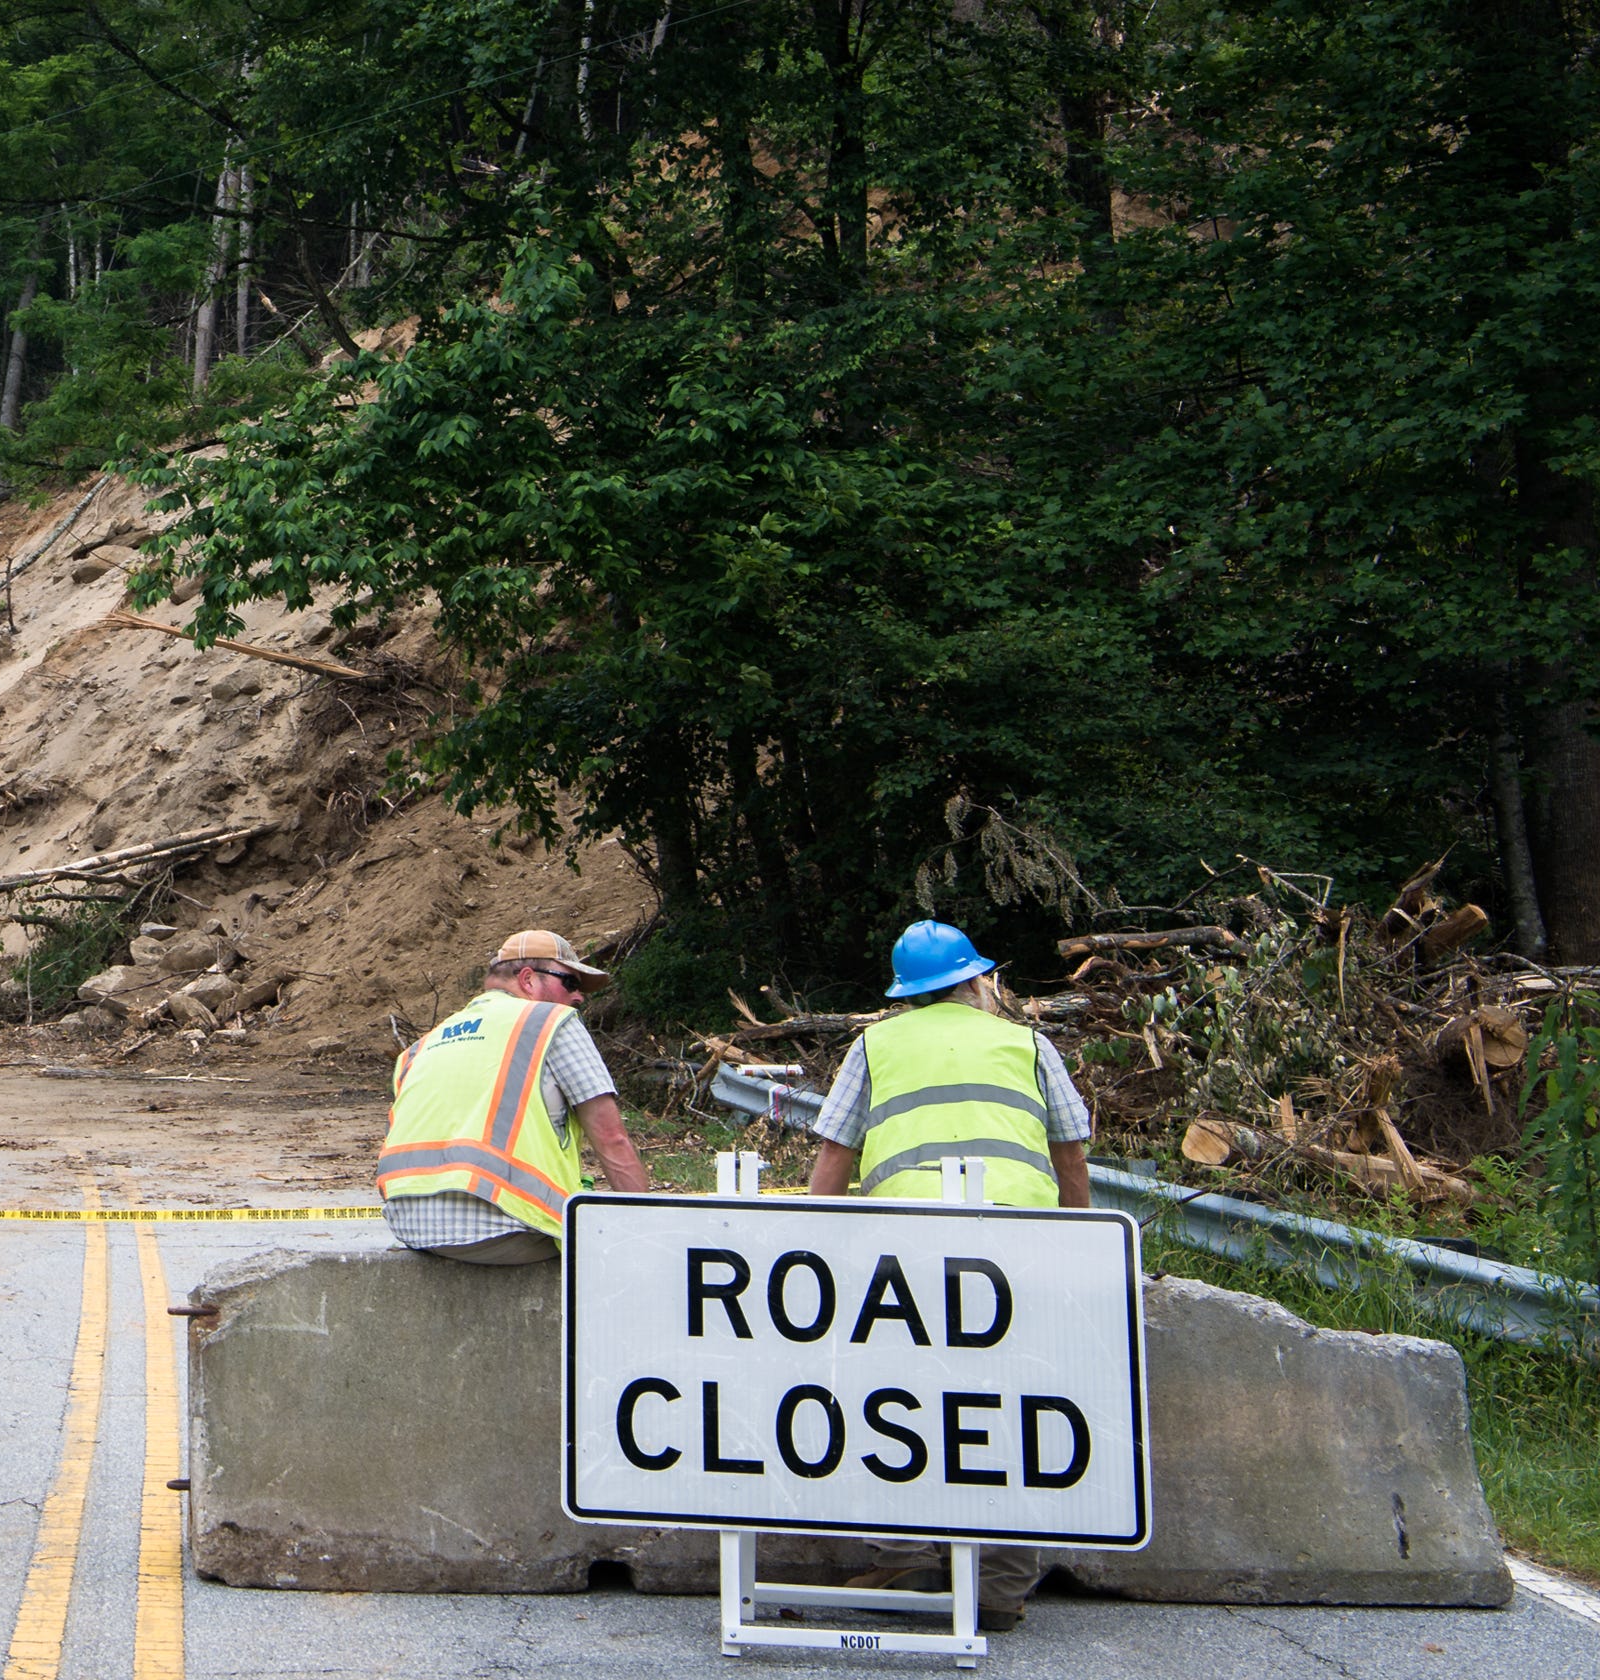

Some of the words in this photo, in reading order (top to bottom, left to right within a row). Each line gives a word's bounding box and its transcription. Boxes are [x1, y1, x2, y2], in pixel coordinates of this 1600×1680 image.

[96, 1211, 107, 1219] FIRE
[108, 1211, 120, 1219] LINE
[129, 1211, 139, 1219] NOT
[140, 1211, 157, 1220] CROSS
[172, 1211, 183, 1220] FIRE
[184, 1211, 195, 1220] LINE
[205, 1211, 215, 1220] NOT
[216, 1211, 233, 1220] CROSS
[248, 1210, 259, 1219] FIRE
[260, 1210, 271, 1219] LINE
[281, 1210, 291, 1219] NOT
[292, 1209, 309, 1219] CROSS
[324, 1209, 335, 1218] FIRE
[336, 1208, 347, 1218] LINE
[357, 1208, 367, 1218] NOT
[368, 1207, 381, 1218] CROS
[687, 1247, 1012, 1348] ROAD
[616, 1377, 1091, 1489] CLOSED
[840, 1635, 881, 1649] NCDOT
